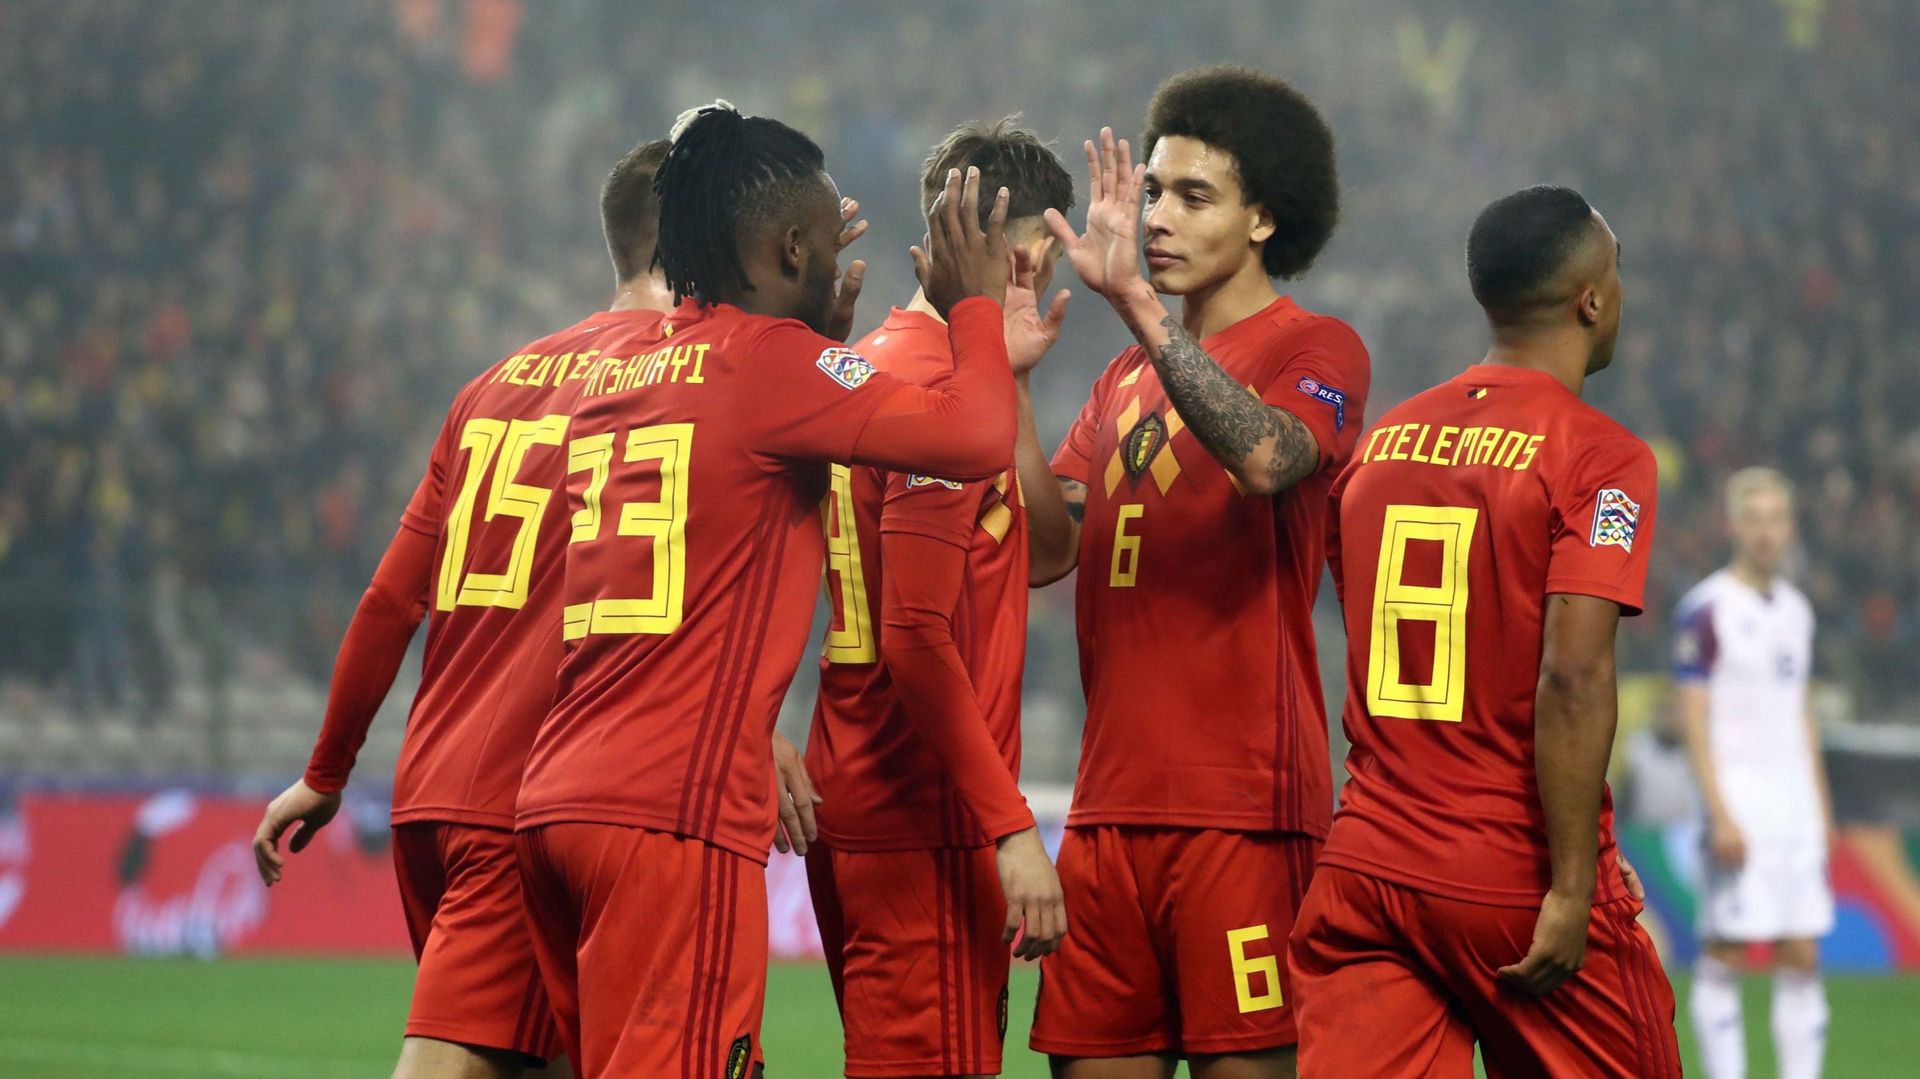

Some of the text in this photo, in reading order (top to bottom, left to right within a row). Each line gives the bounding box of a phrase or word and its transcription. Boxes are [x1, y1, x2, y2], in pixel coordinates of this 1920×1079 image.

[436, 414, 571, 612] 15
[1362, 423, 1546, 471] TIELEMANS
[563, 423, 695, 642] 23
[1109, 504, 1144, 588] 6
[1366, 504, 1479, 723] 8
[1226, 924, 1284, 1014] 6
